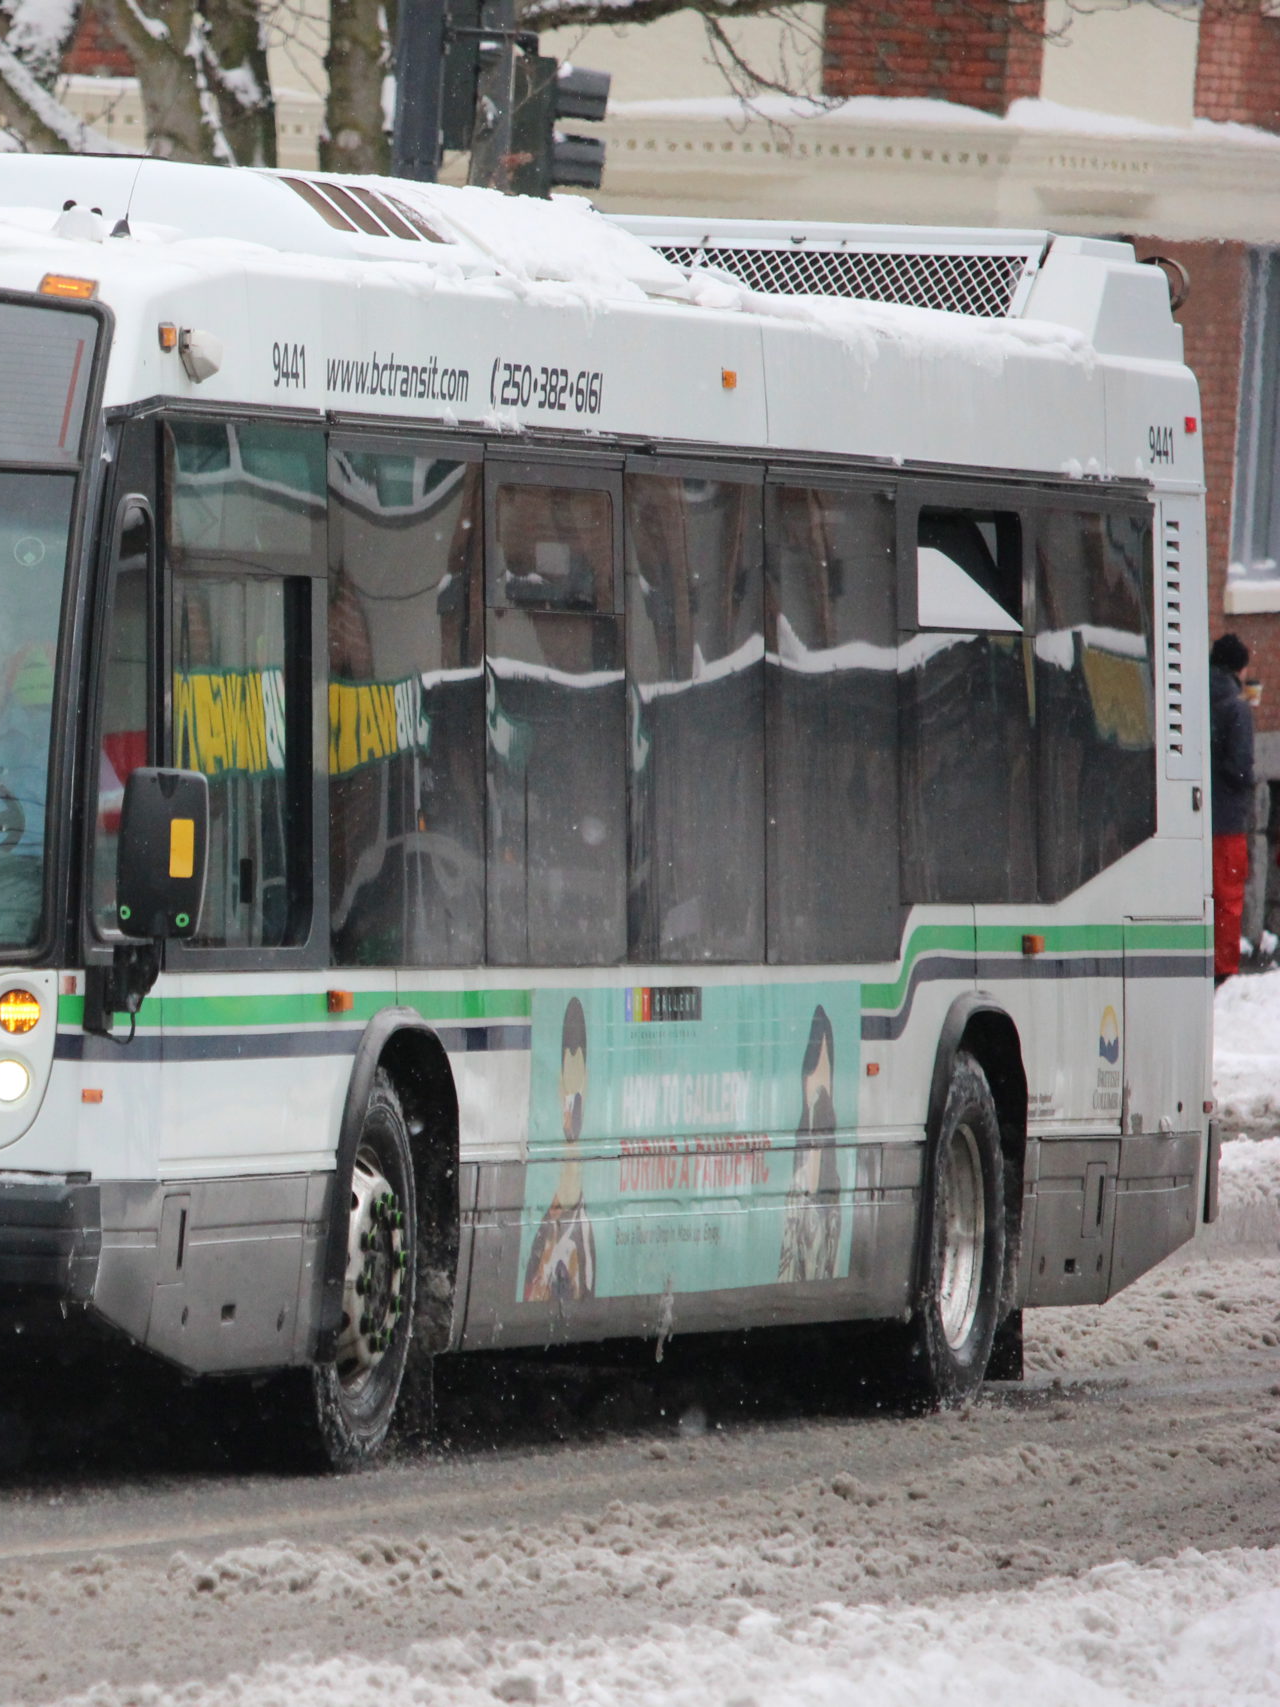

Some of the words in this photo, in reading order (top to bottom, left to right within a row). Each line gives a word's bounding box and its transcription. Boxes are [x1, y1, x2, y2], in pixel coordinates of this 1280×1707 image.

[273, 341, 306, 389] 9441
[327, 351, 470, 402] www.bctransit.com
[1149, 425, 1174, 464] 9441
[622, 1075, 657, 1128] HOW
[661, 1073, 680, 1125] TO
[684, 1071, 752, 1124] GALLERY
[620, 1137, 678, 1192] DURING
